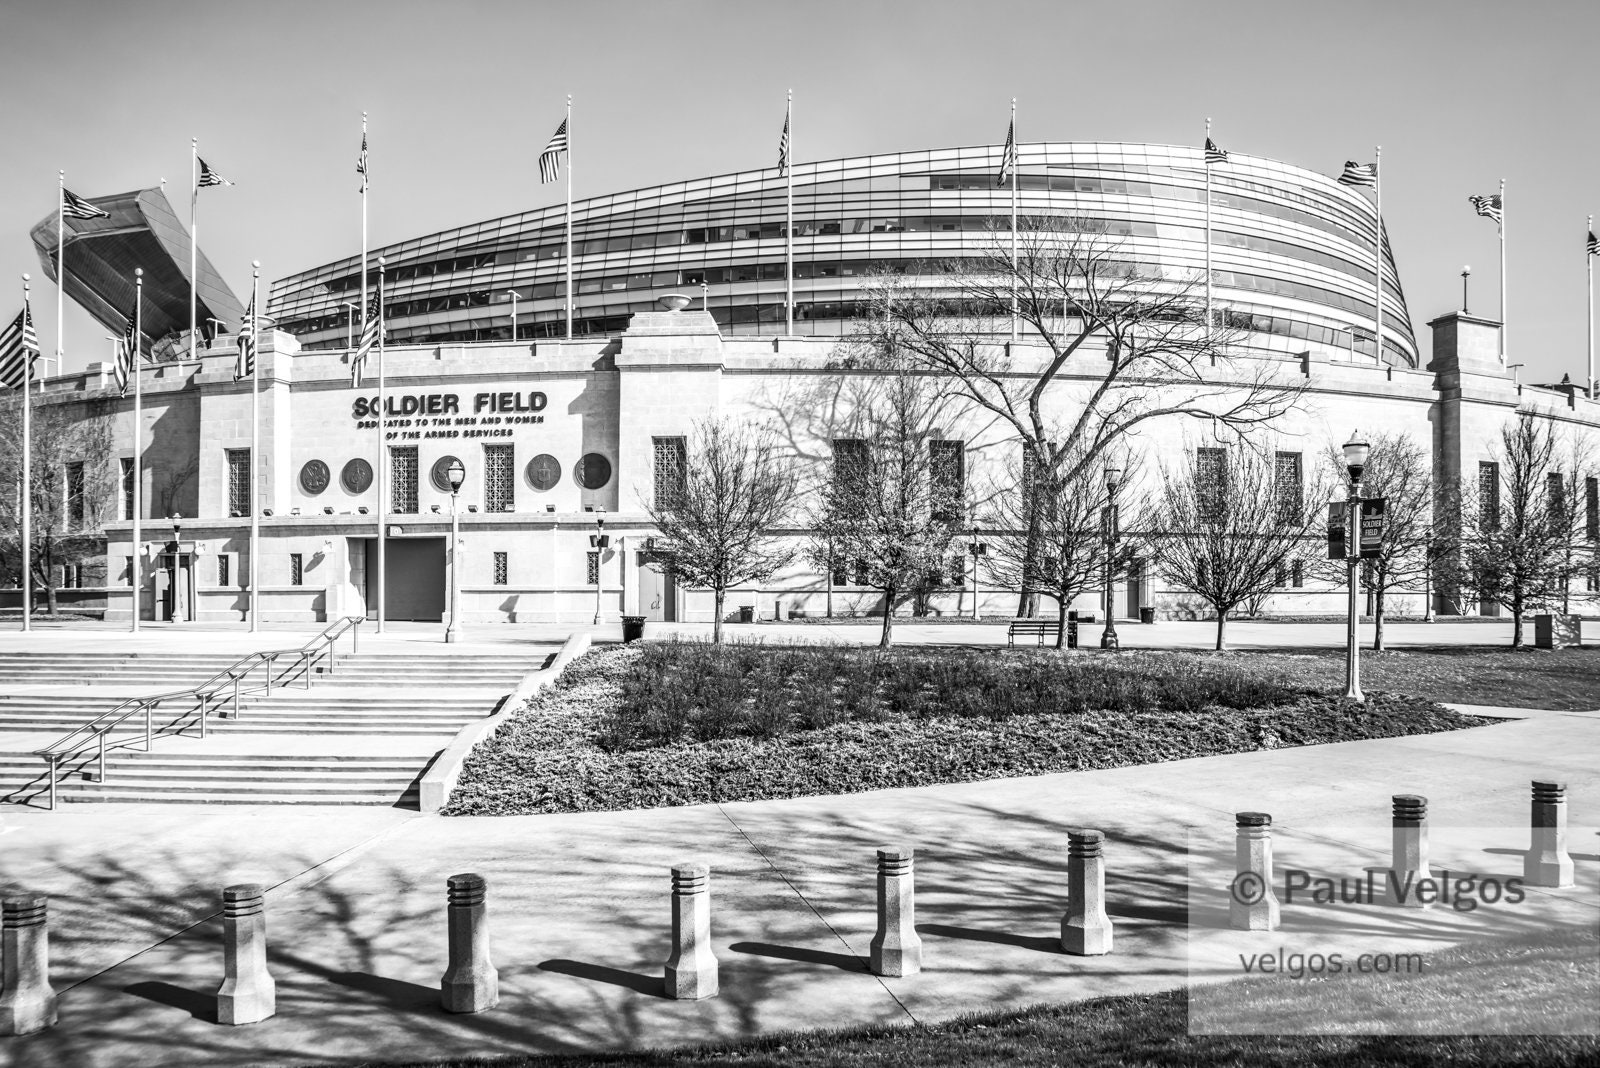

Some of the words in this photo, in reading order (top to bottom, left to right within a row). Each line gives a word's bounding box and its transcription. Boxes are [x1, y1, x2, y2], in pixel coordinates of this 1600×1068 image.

[354, 394, 459, 417] SOLDIER
[475, 391, 548, 413] FIELD
[415, 418, 429, 426] TO
[432, 418, 452, 426] THE
[455, 417, 477, 426] MEN
[480, 416, 502, 425] AND
[505, 415, 544, 425] WOMEN
[386, 431, 399, 440] OF
[402, 431, 421, 440] THE
[424, 430, 459, 439] ARMED
[463, 428, 514, 438] SERVICES
[1363, 520, 1382, 528] SOLDIER
